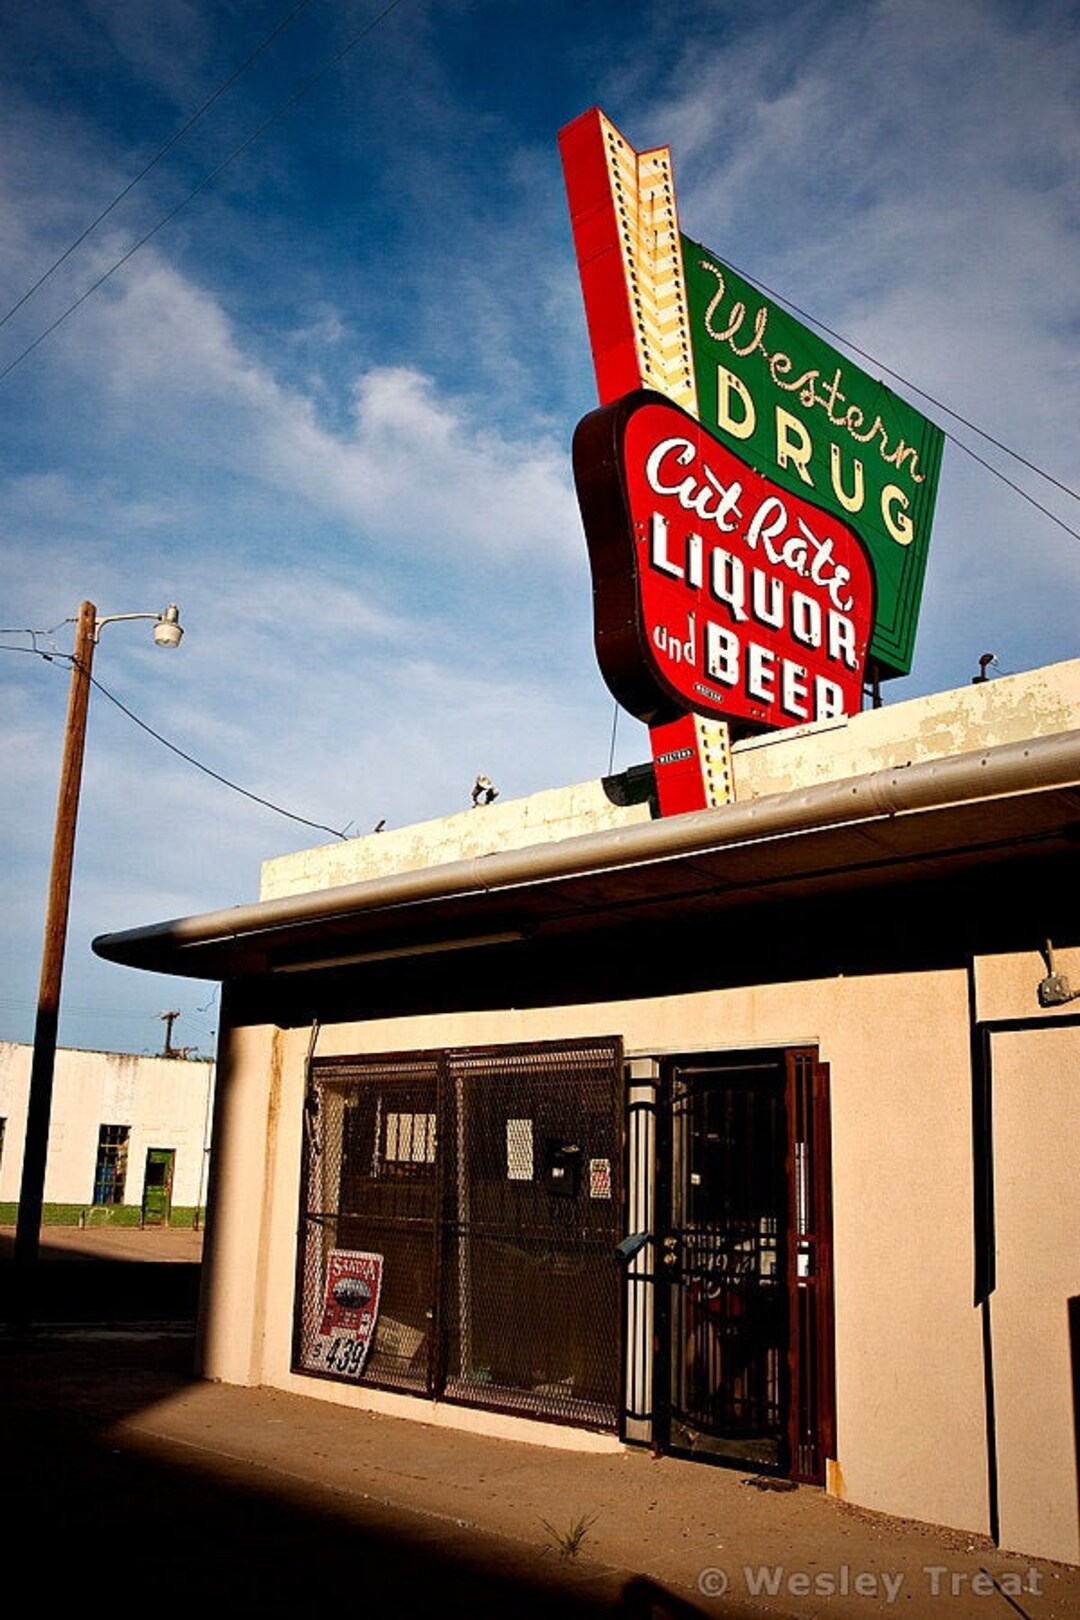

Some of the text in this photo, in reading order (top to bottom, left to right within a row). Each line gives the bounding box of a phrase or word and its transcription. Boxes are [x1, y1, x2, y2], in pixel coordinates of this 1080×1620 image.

[698, 260, 926, 482] Western
[717, 364, 915, 546] DRUG
[645, 437, 854, 611] Cut Rate
[650, 511, 860, 670] LIQUOR
[653, 611, 844, 721] and BEER
